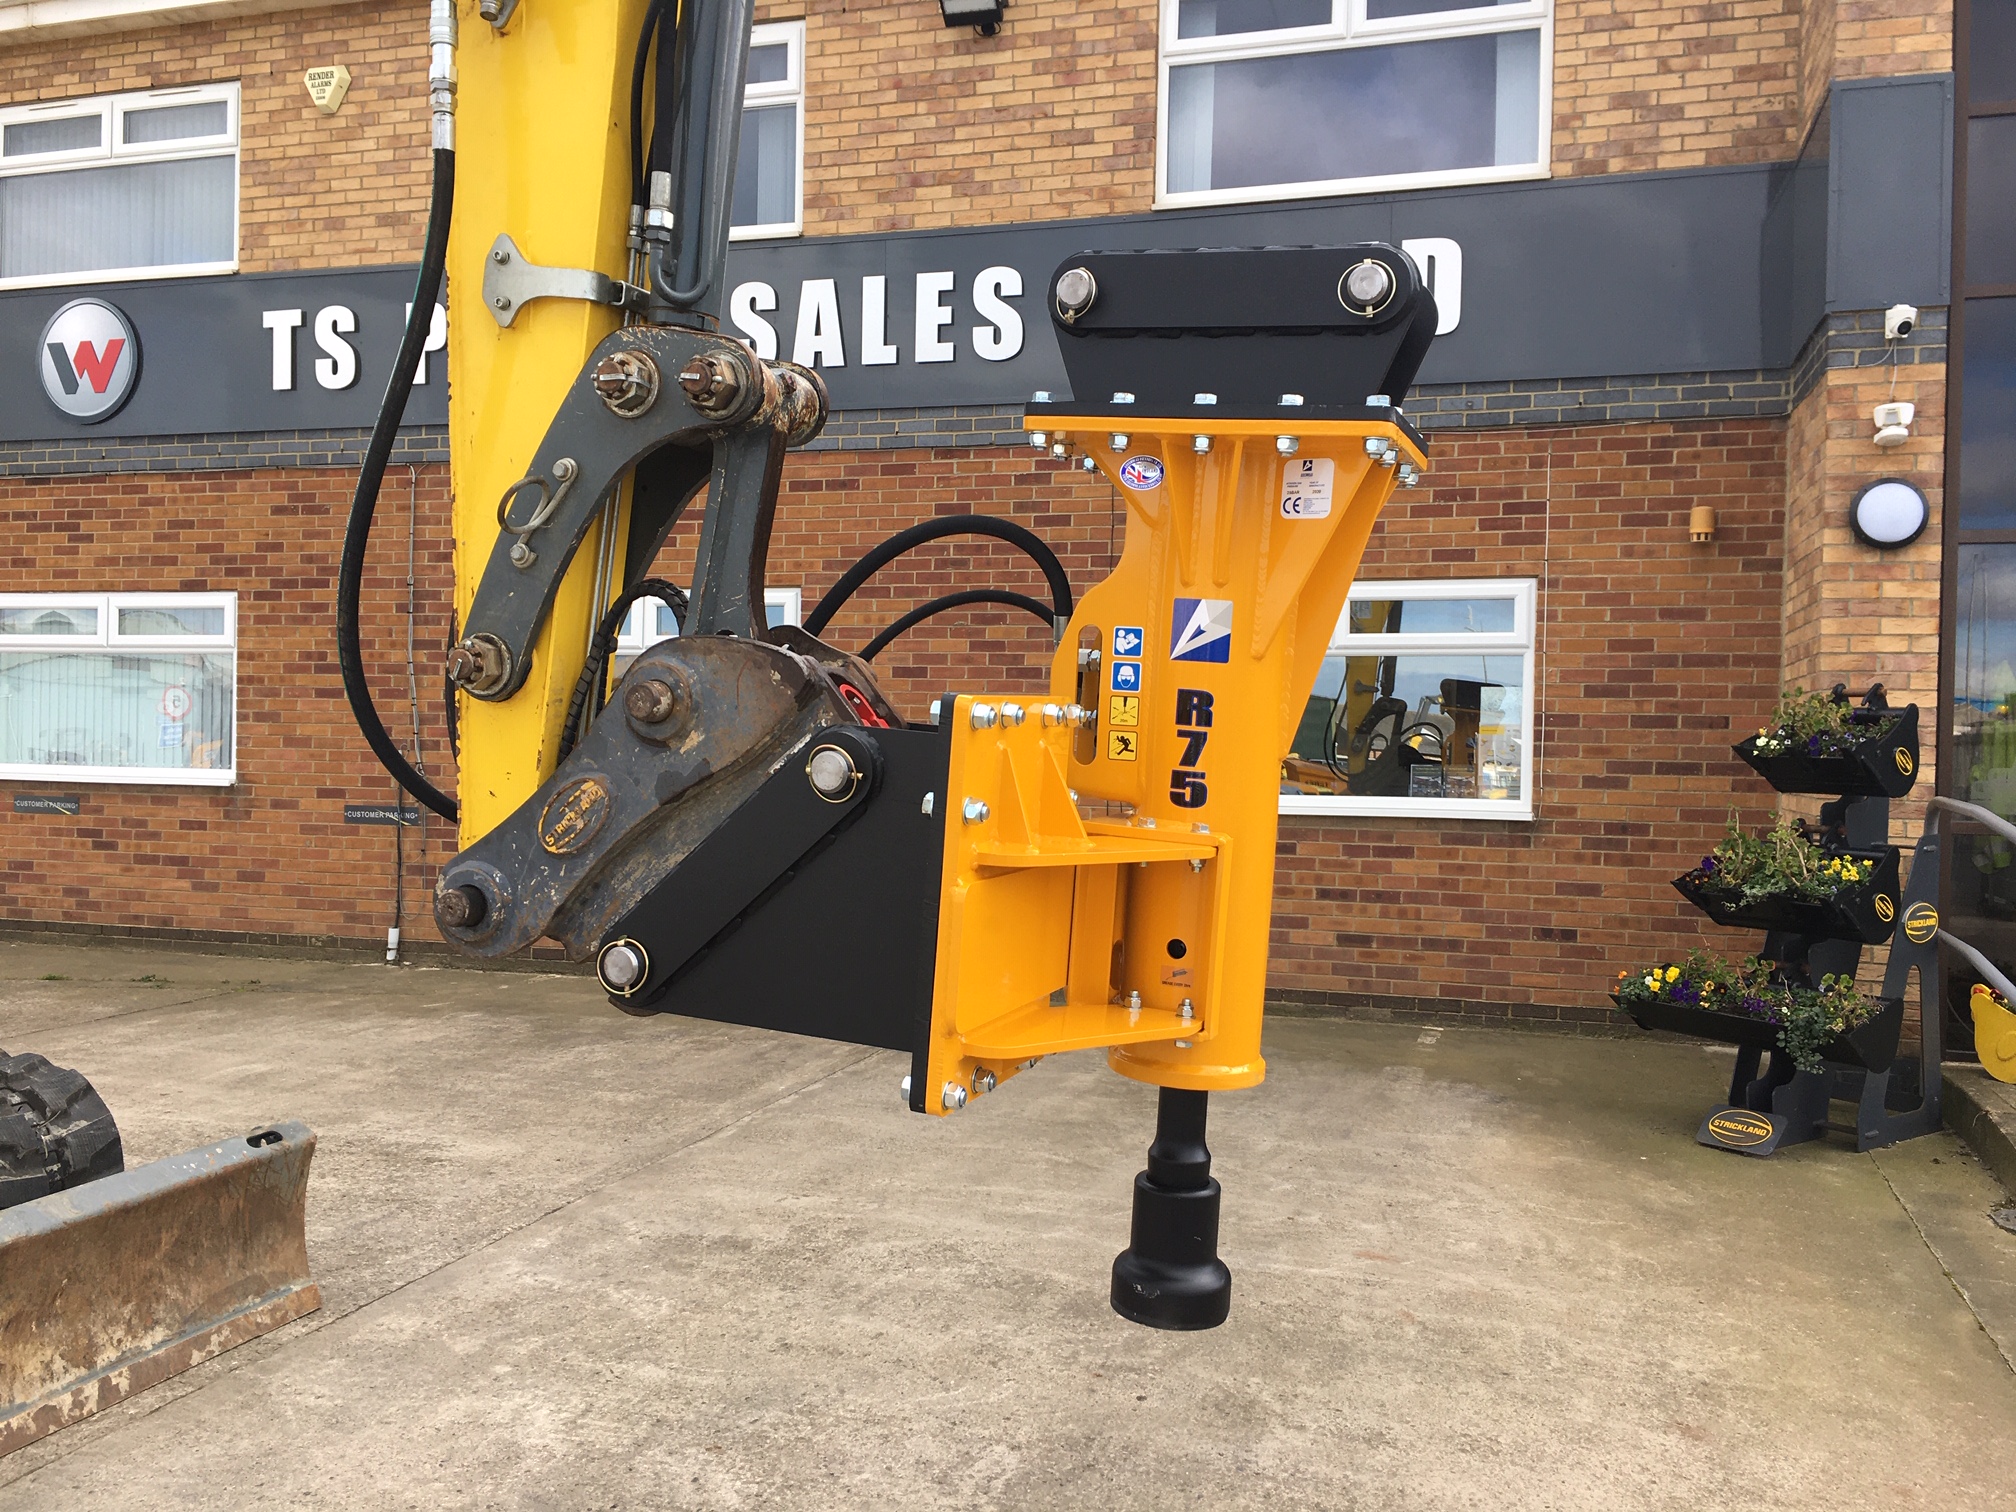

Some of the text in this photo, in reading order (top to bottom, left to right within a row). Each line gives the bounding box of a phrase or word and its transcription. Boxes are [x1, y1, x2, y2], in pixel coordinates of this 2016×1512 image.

[308, 70, 335, 81] RENDER
[310, 80, 332, 89] ALARMS
[262, 305, 359, 391] TS
[730, 265, 1024, 368] SALES
[1169, 688, 1215, 809] R75
[16, 800, 76, 809] CUSTOMER PARKING
[347, 810, 384, 818] CUSTOMER
[1907, 918, 1937, 929] STRICKLAND
[1713, 1119, 1768, 1137] STRICKLAND
